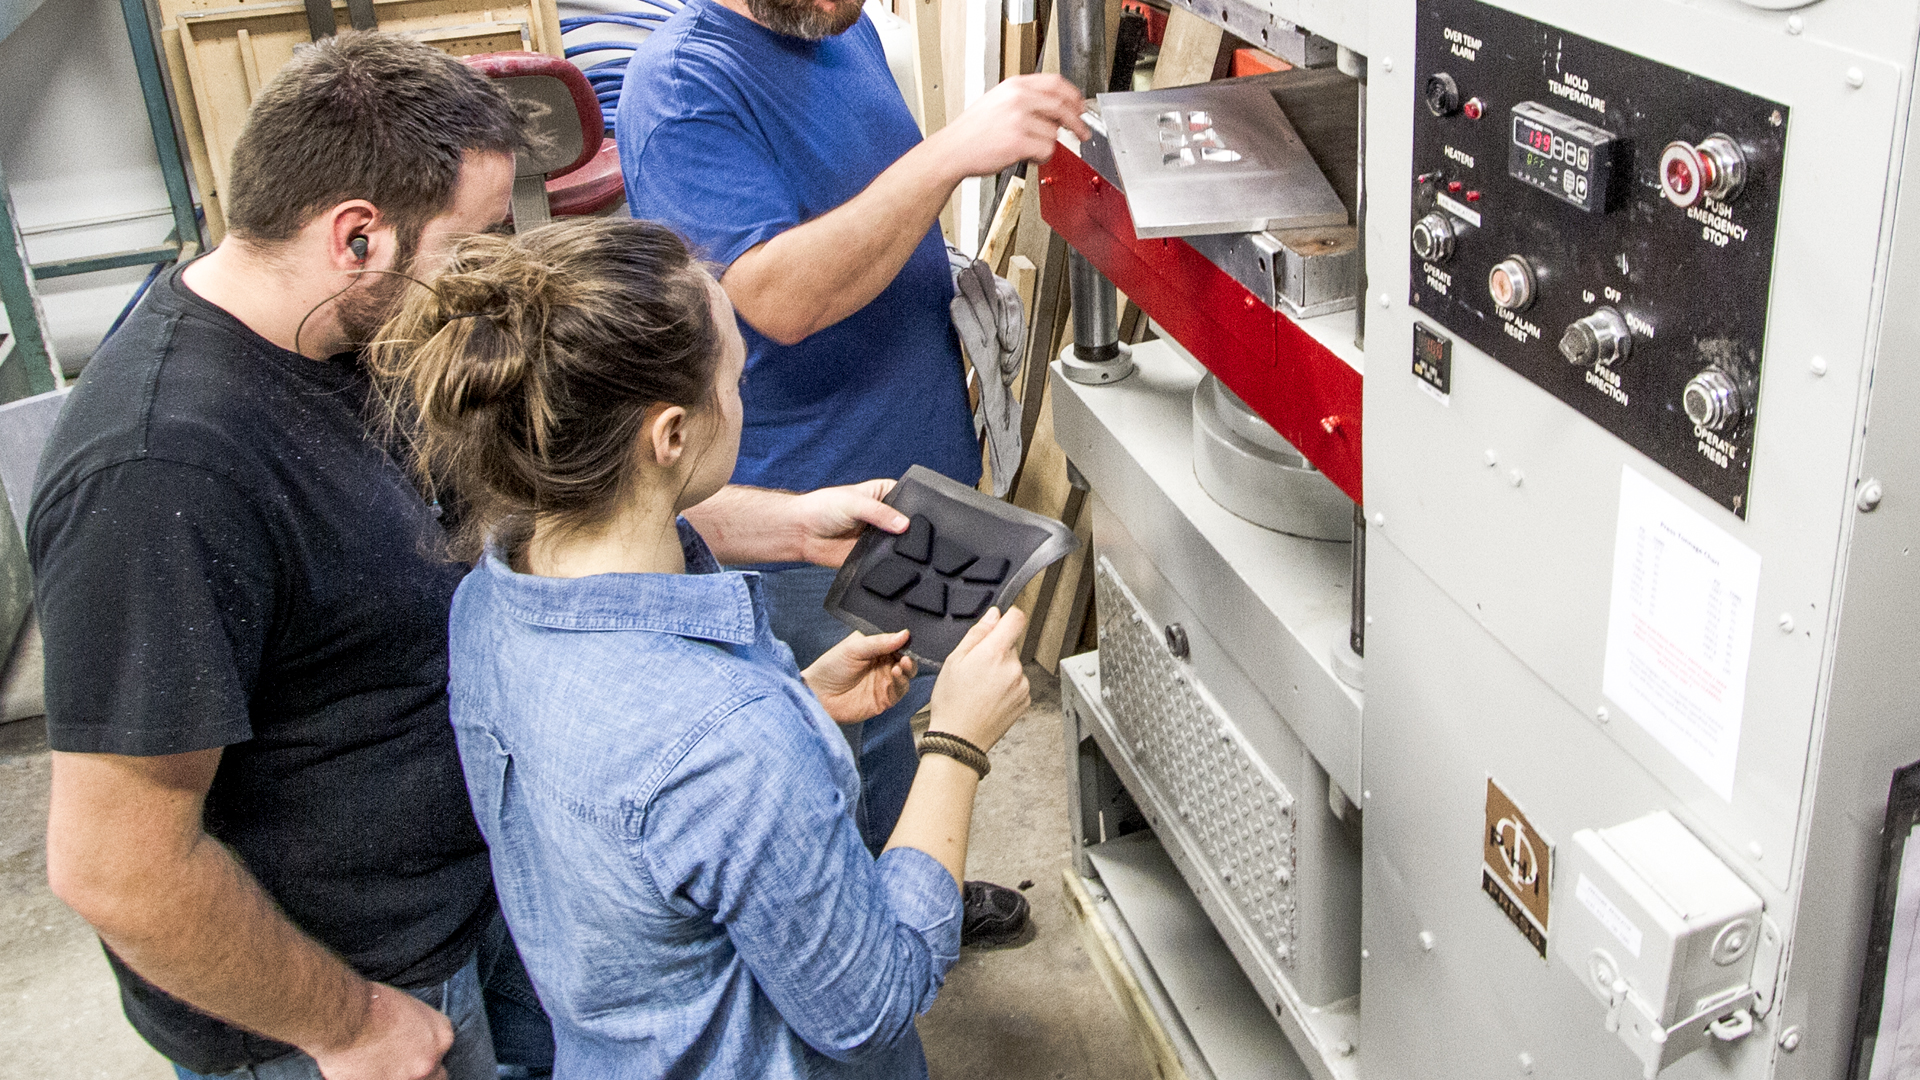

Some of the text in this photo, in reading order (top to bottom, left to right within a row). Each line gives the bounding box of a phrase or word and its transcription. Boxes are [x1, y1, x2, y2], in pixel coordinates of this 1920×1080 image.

[1444, 27, 1482, 51] OVER TEMP
[1451, 43, 1475, 62] ALARM
[1564, 72, 1589, 92] MOLD
[1548, 79, 1606, 113] TEMPERATURE
[1529, 130, 1551, 152] 139
[1444, 145, 1475, 169] HEATERS
[1705, 197, 1733, 219] PUSH
[1687, 205, 1748, 241] EMERGENCY
[1702, 226, 1729, 248] STOP
[1423, 262, 1452, 287] OPERATE
[1426, 275, 1447, 295] PRESS
[1583, 289, 1596, 304] UP
[1604, 286, 1622, 303] OFF
[1495, 304, 1541, 340] TEMP ALARM
[1504, 322, 1528, 344] RESET
[1626, 312, 1655, 339] DOWN
[1595, 363, 1621, 388] PRESS
[1585, 370, 1629, 407] DIRECTION
[1694, 424, 1736, 460] OPERATE
[1698, 440, 1729, 469] PRESS
